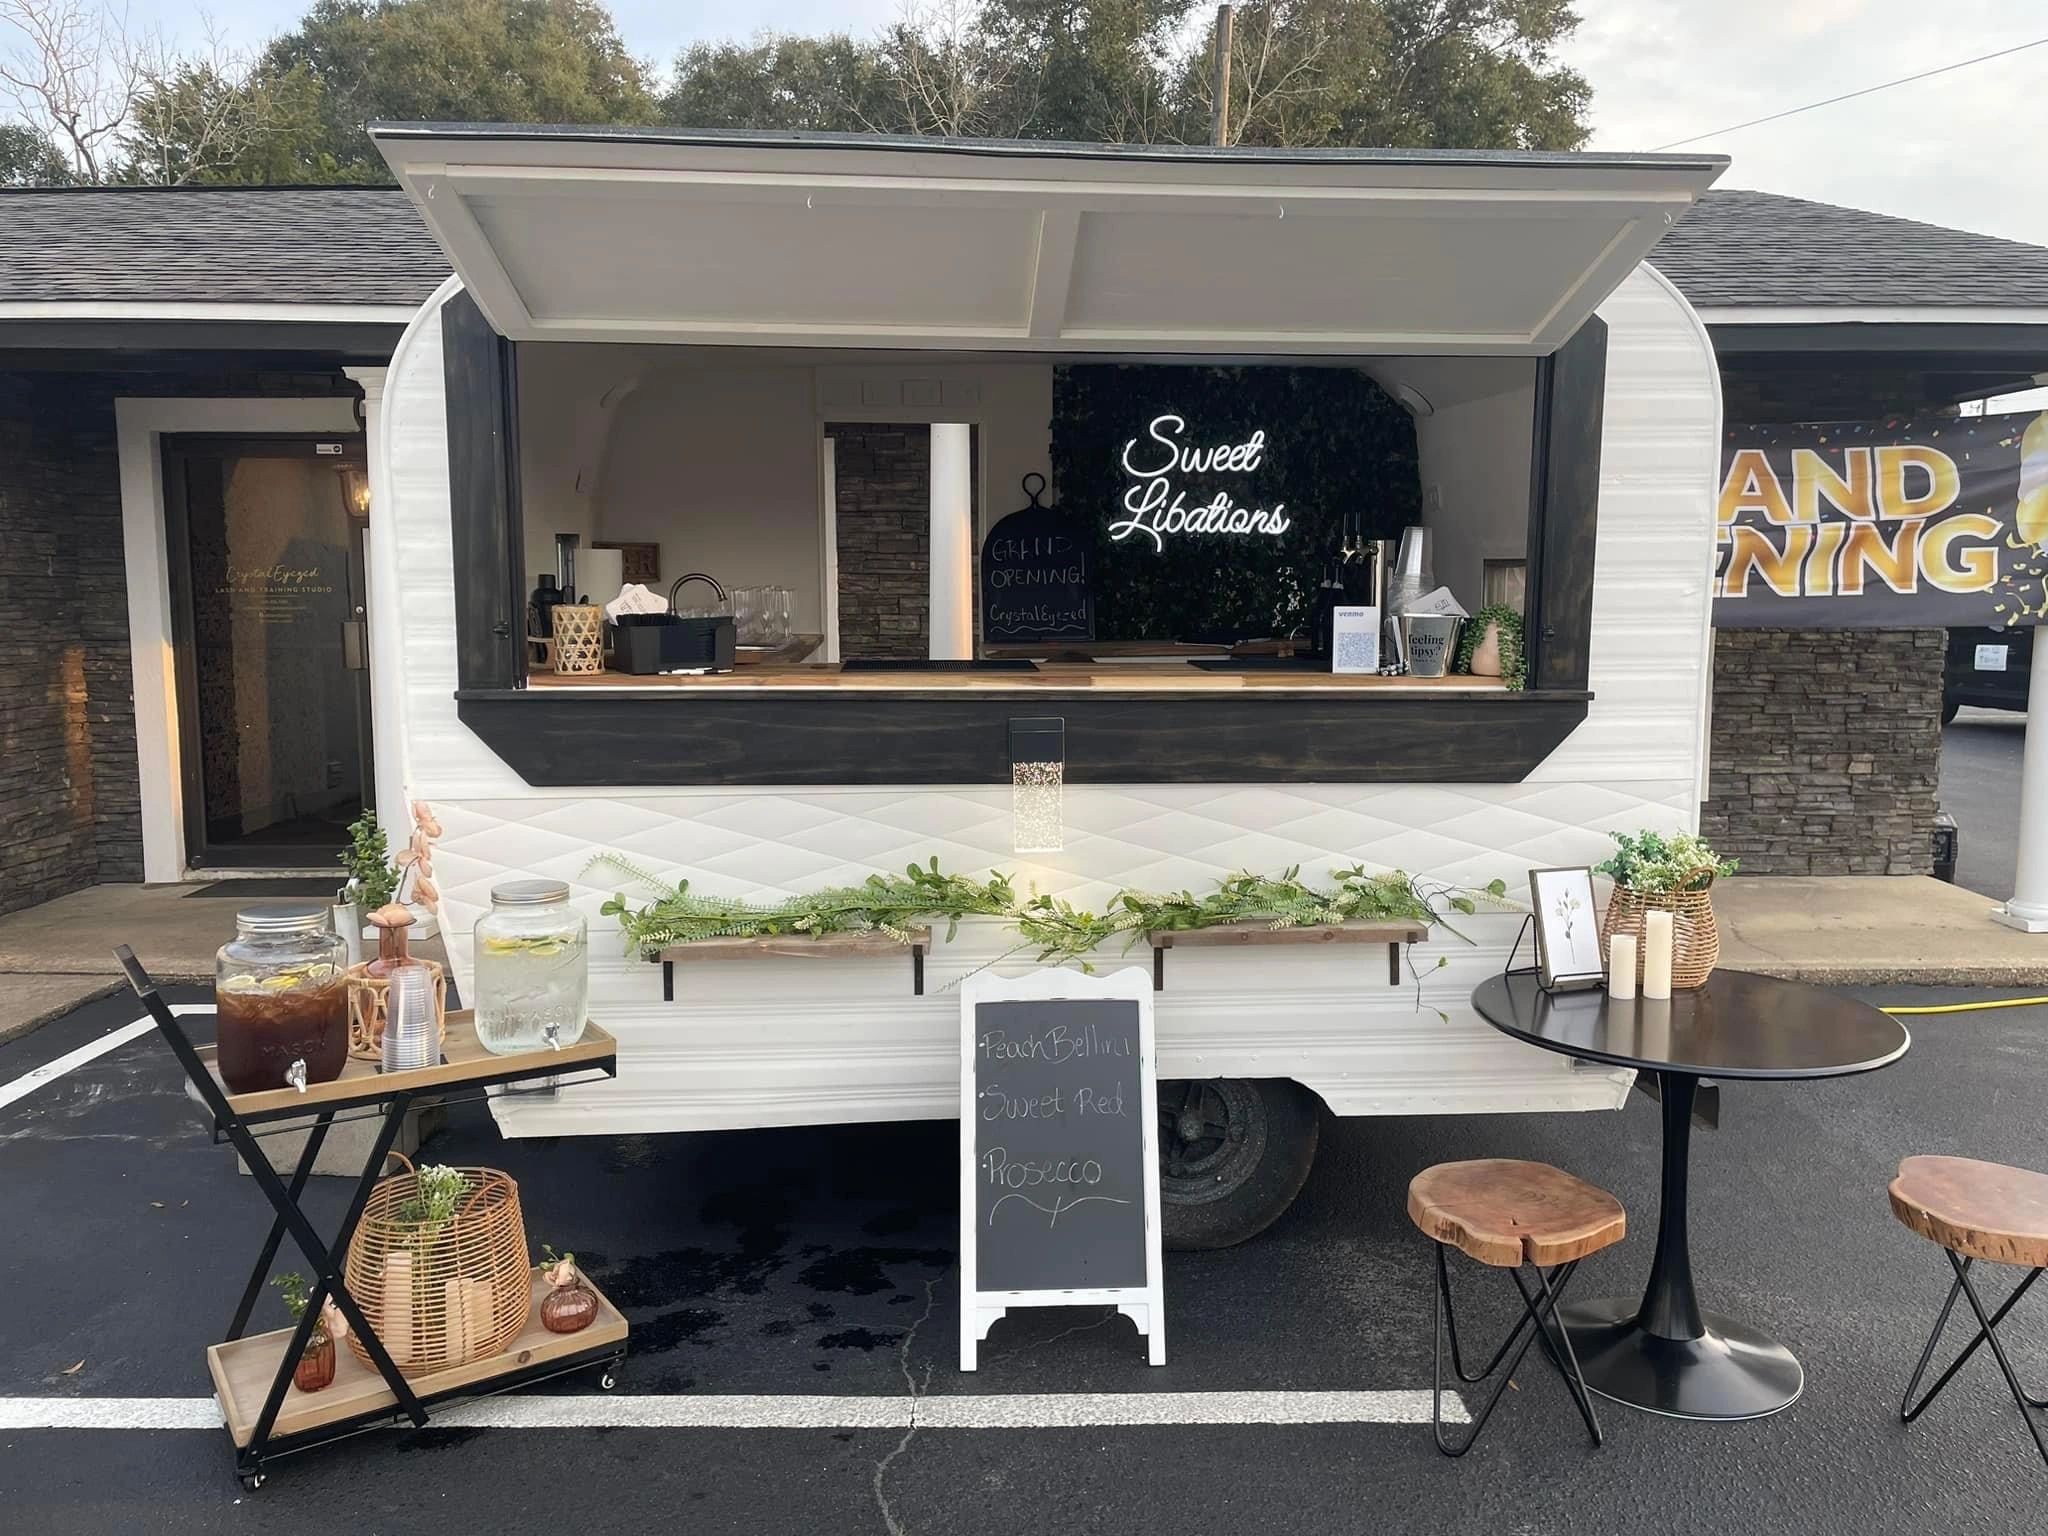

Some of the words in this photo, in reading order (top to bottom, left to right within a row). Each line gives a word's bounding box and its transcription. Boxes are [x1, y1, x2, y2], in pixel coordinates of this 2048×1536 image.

[1123, 415, 1265, 477] Sweet
[1108, 477, 1290, 553] Libations
[991, 552, 1086, 588] OPENING!
[1408, 634, 1444, 646] feeling
[1410, 646, 1441, 657] tipsy?
[982, 1030, 1042, 1059] Peach
[983, 1084, 1064, 1121] Sweet
[1073, 1081, 1127, 1118] Red
[983, 1147, 1102, 1188] Prosecco
